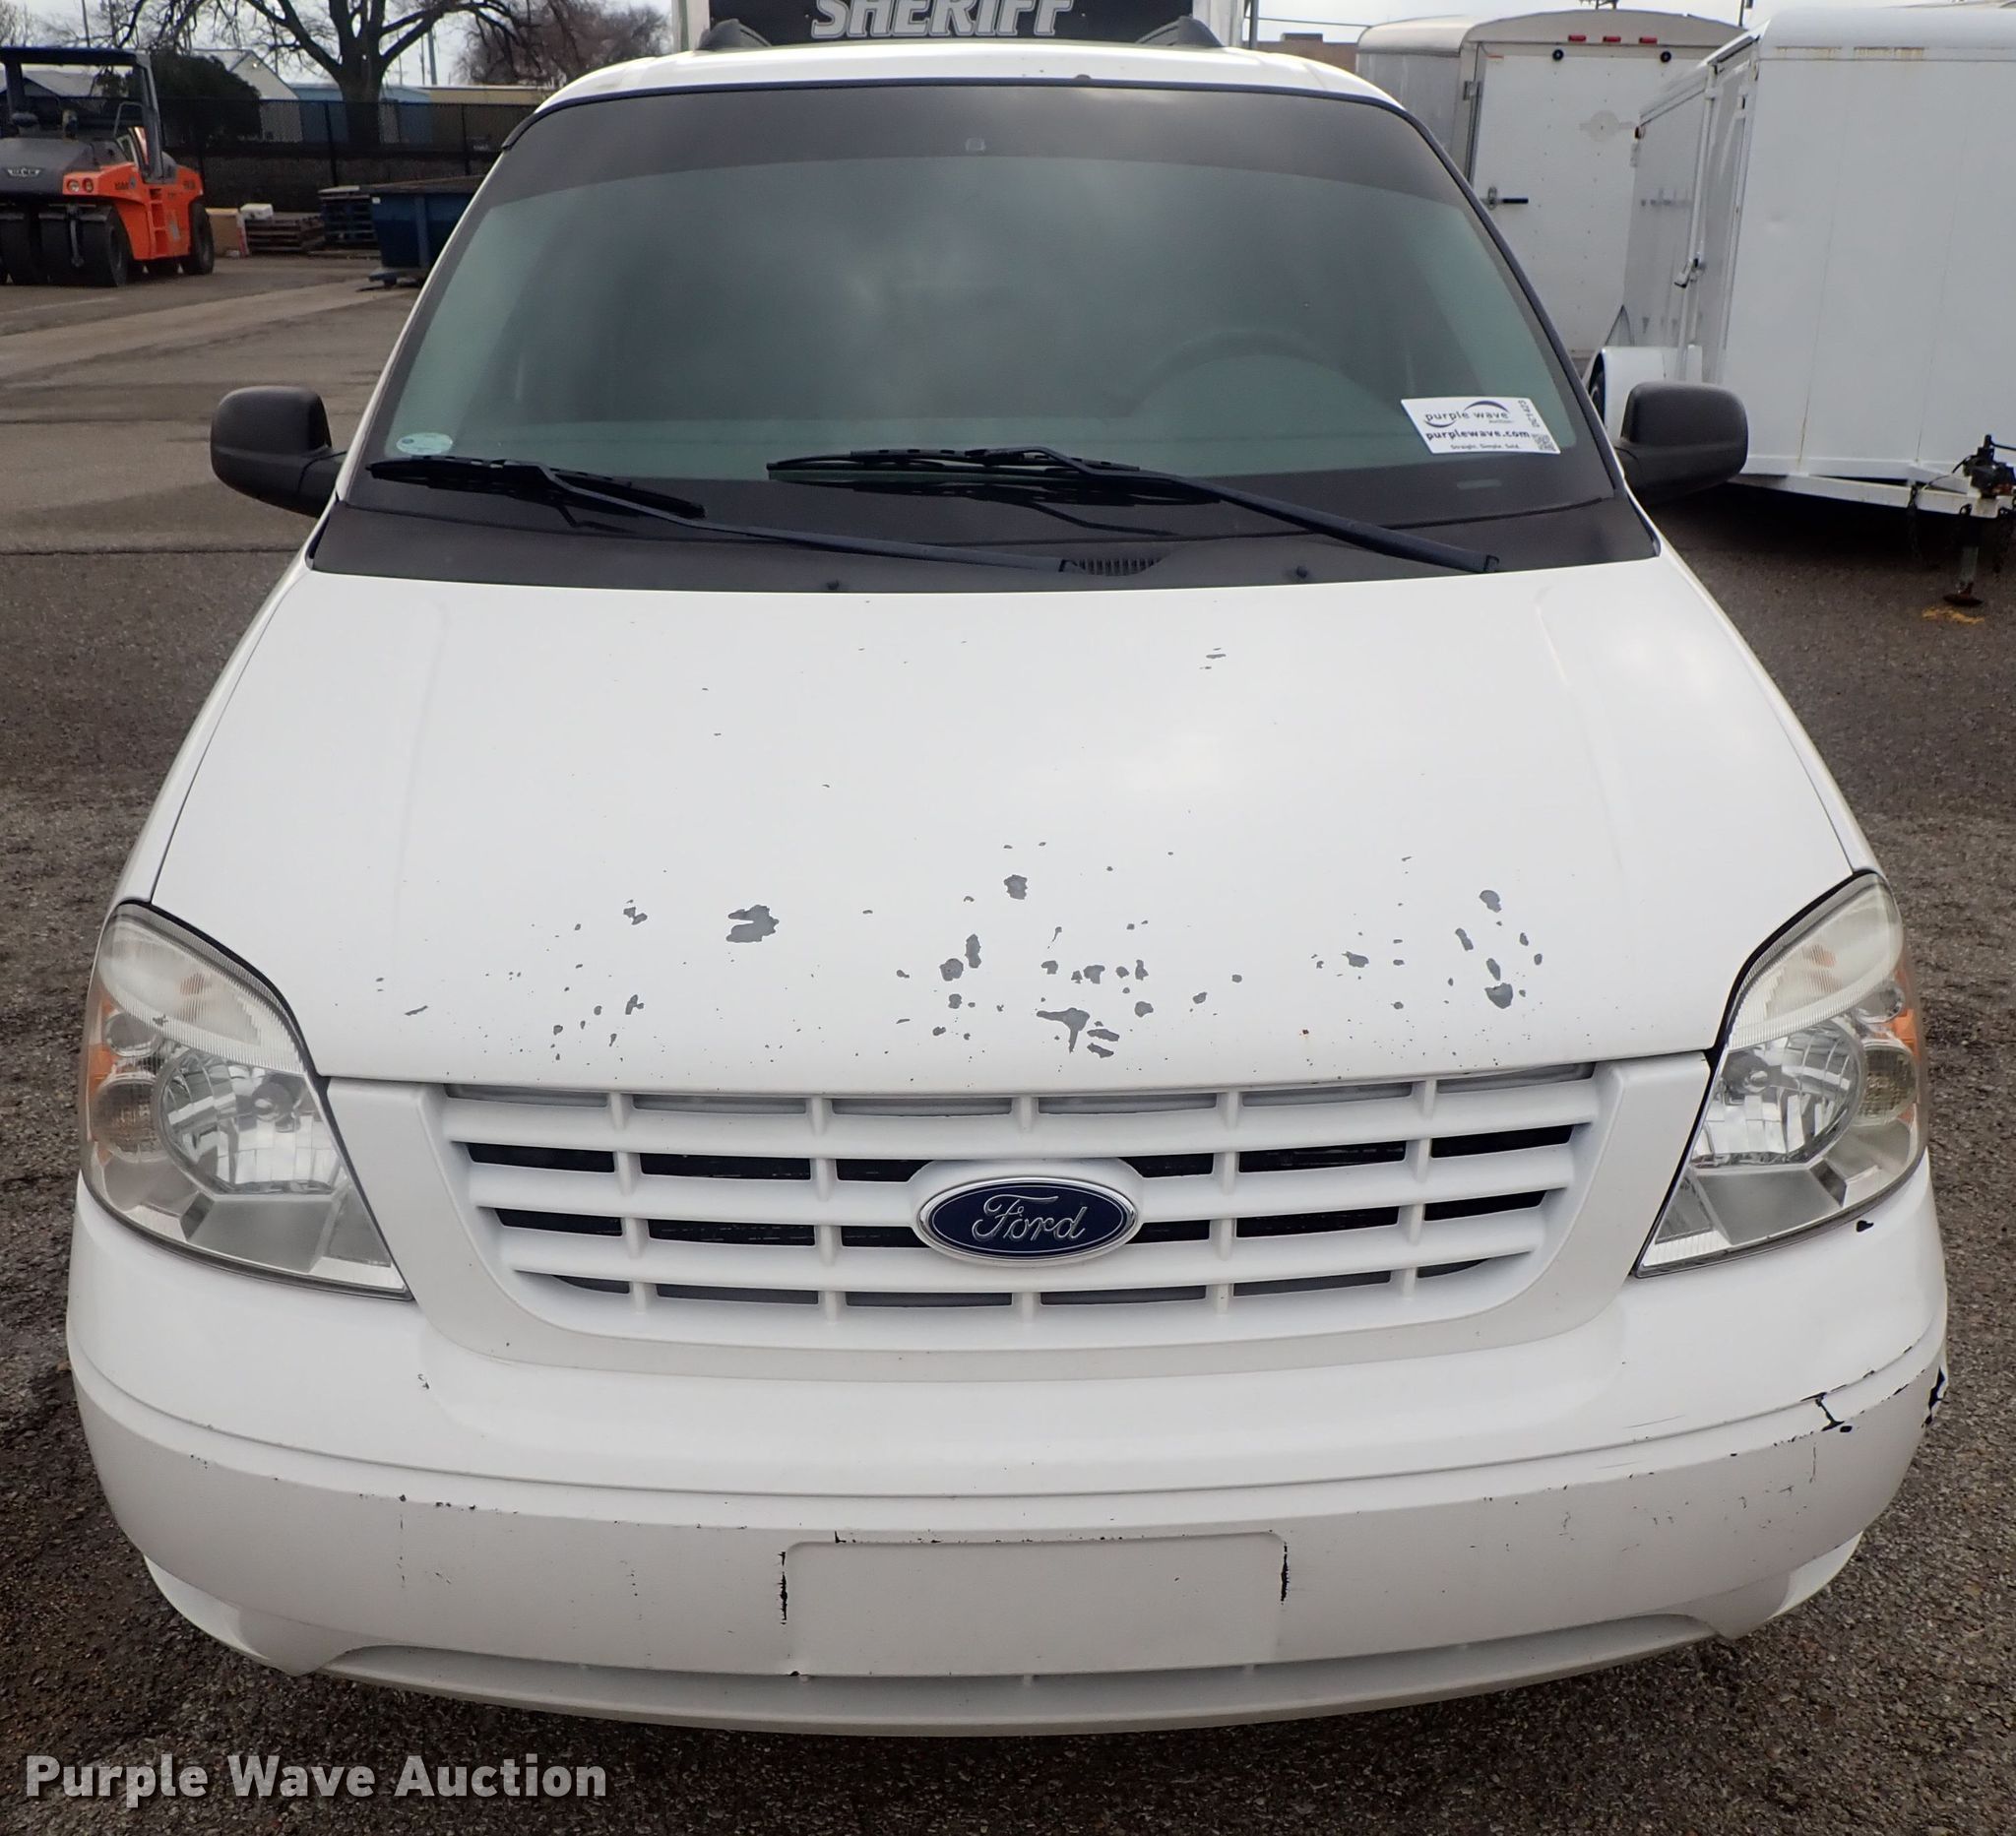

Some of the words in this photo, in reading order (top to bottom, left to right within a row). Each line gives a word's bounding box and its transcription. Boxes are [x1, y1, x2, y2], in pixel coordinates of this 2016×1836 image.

[811, 0, 1073, 38] SHERIFF
[1425, 411, 1470, 421] purple
[1426, 428, 1530, 441] purplewave.com
[972, 1194, 1088, 1241] Ford
